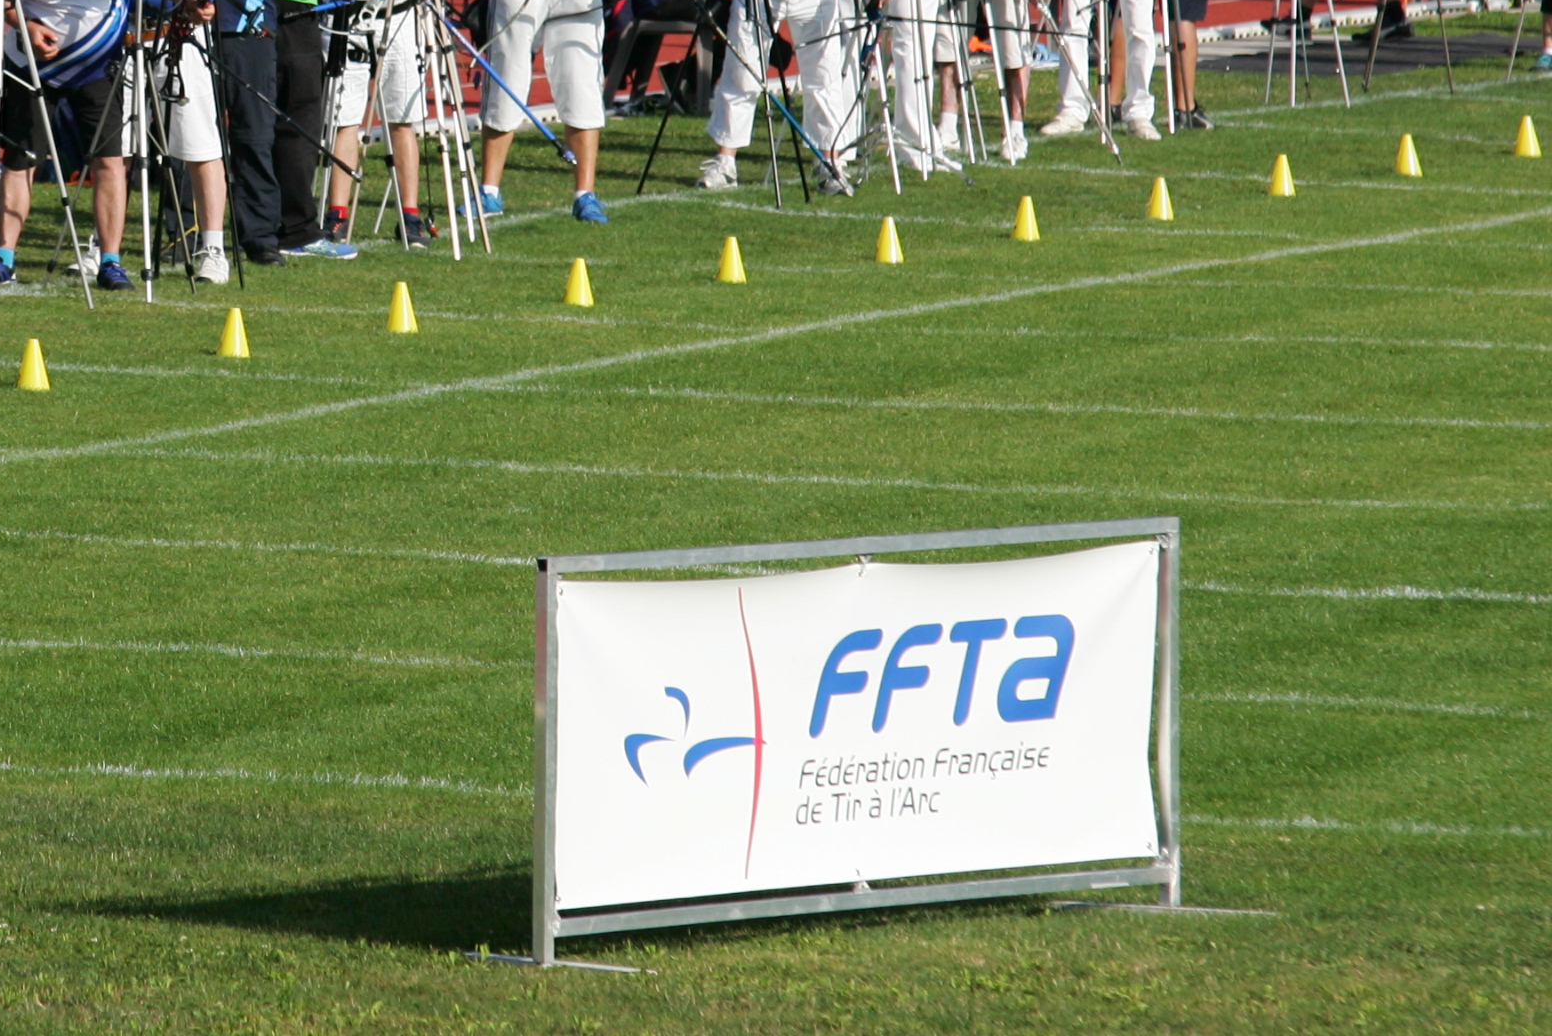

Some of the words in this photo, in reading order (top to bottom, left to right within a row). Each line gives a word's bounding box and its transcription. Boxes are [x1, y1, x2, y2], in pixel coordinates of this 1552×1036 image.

[798, 751, 926, 789] Fédération
[932, 741, 1051, 780] Française
[795, 795, 824, 825] de
[831, 791, 862, 823] Tir
[869, 788, 883, 819] à
[889, 786, 941, 817] l'Arc
